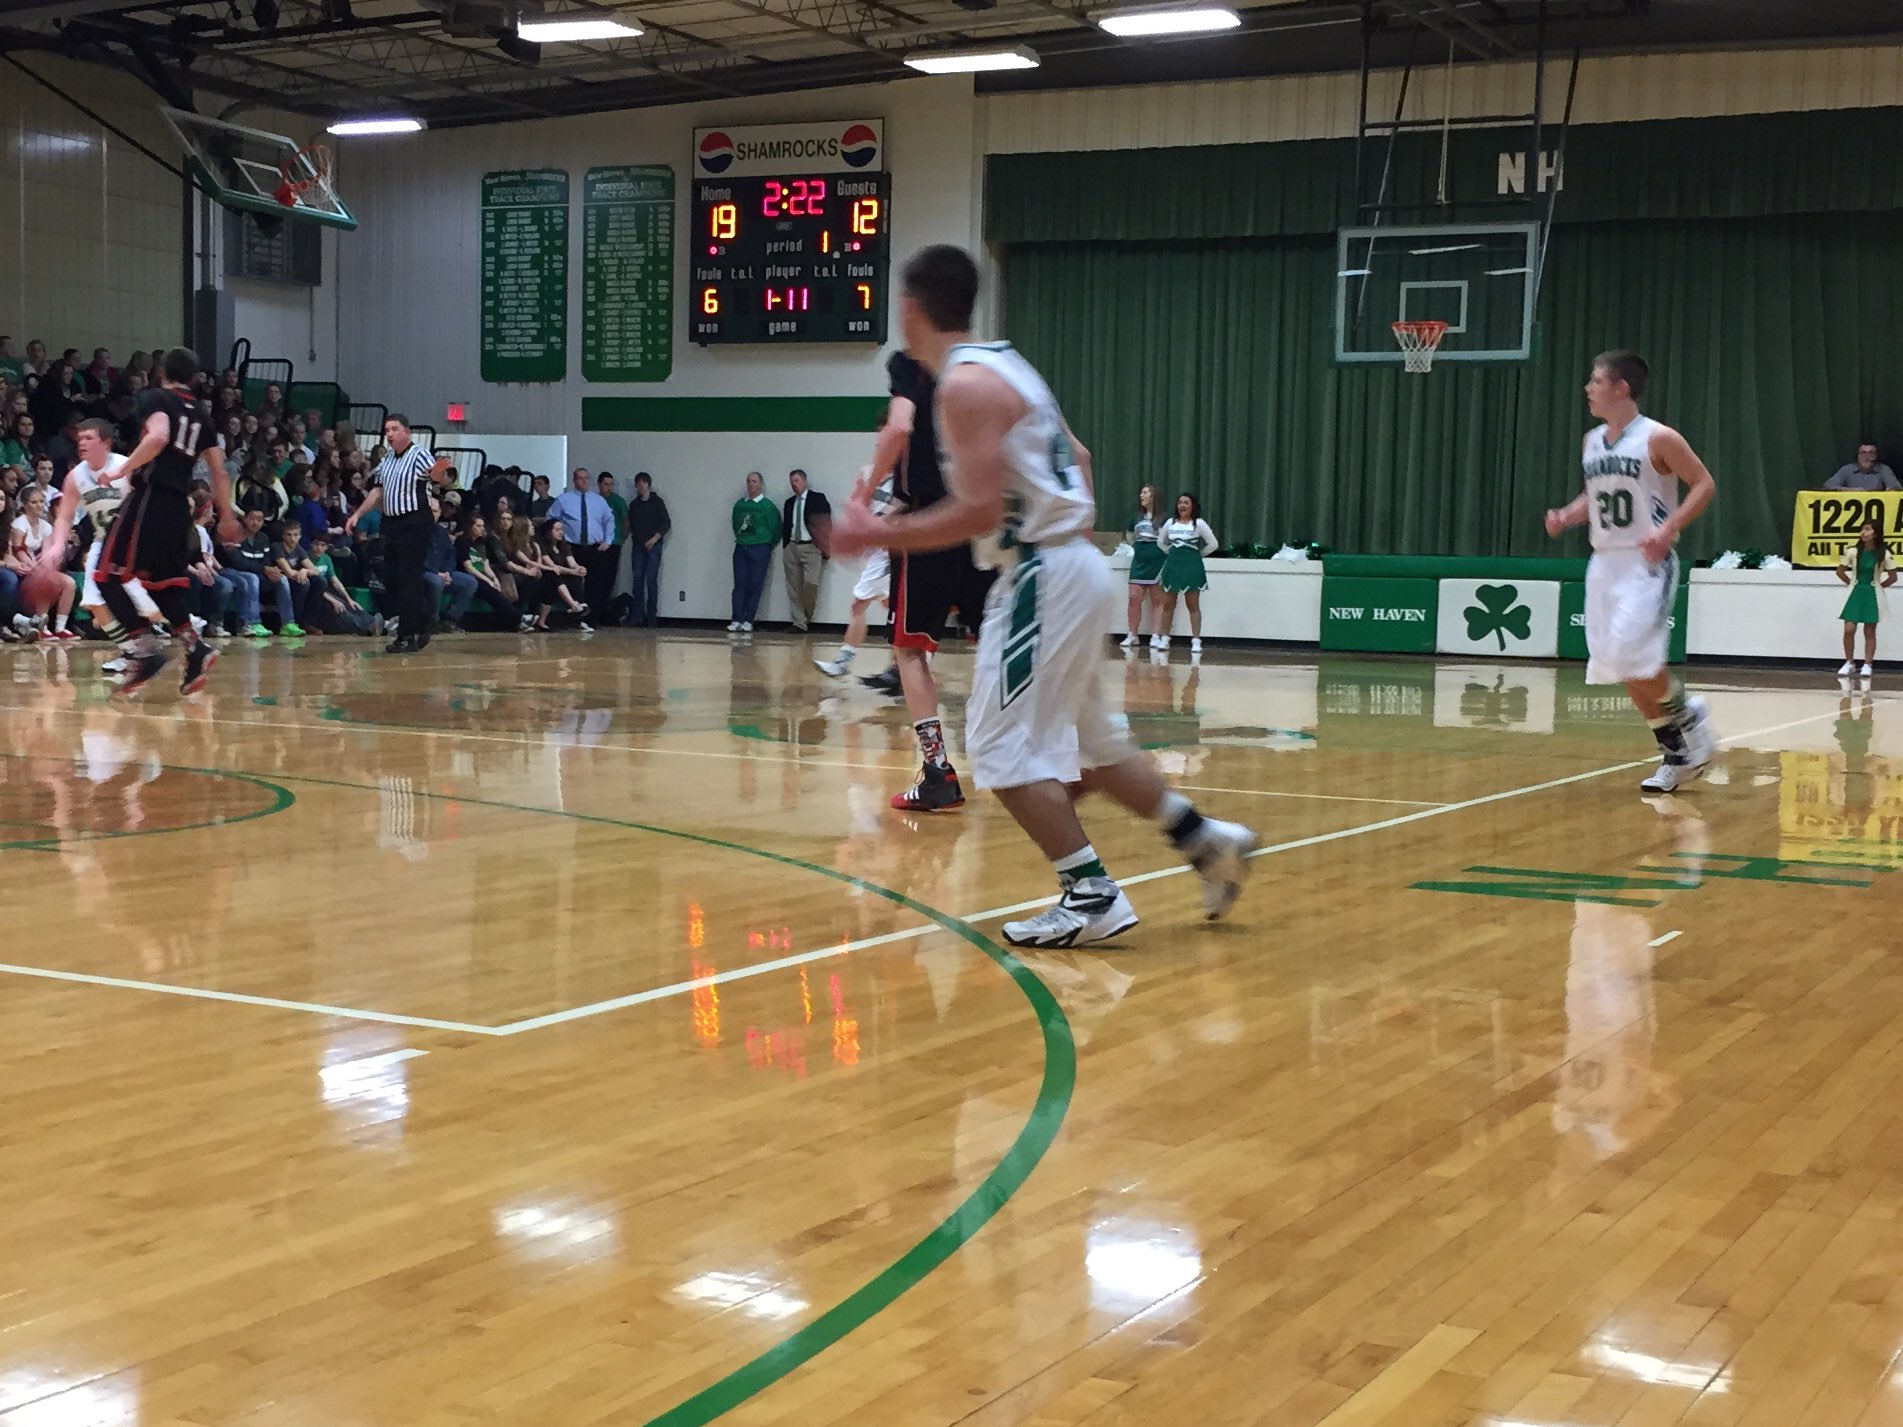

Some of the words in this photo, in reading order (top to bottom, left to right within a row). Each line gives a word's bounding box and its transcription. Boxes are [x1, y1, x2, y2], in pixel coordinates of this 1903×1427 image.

[736, 138, 839, 161] SHAMROCKS
[701, 186, 732, 201] Home
[763, 180, 826, 217] 2:22
[837, 180, 877, 196] Guests
[711, 204, 737, 239] 19
[852, 199, 879, 235] 12
[766, 239, 803, 255] period
[822, 230, 829, 254] 1
[765, 264, 802, 280] player
[704, 288, 719, 314] 6
[857, 285, 870, 310] 7
[698, 322, 719, 334] won
[768, 321, 797, 336] game
[848, 320, 870, 332] won
[174, 415, 202, 457] 11
[1596, 487, 1634, 531] 20
[1329, 607, 1365, 620] NEW
[1372, 607, 1427, 622] HAVEN
